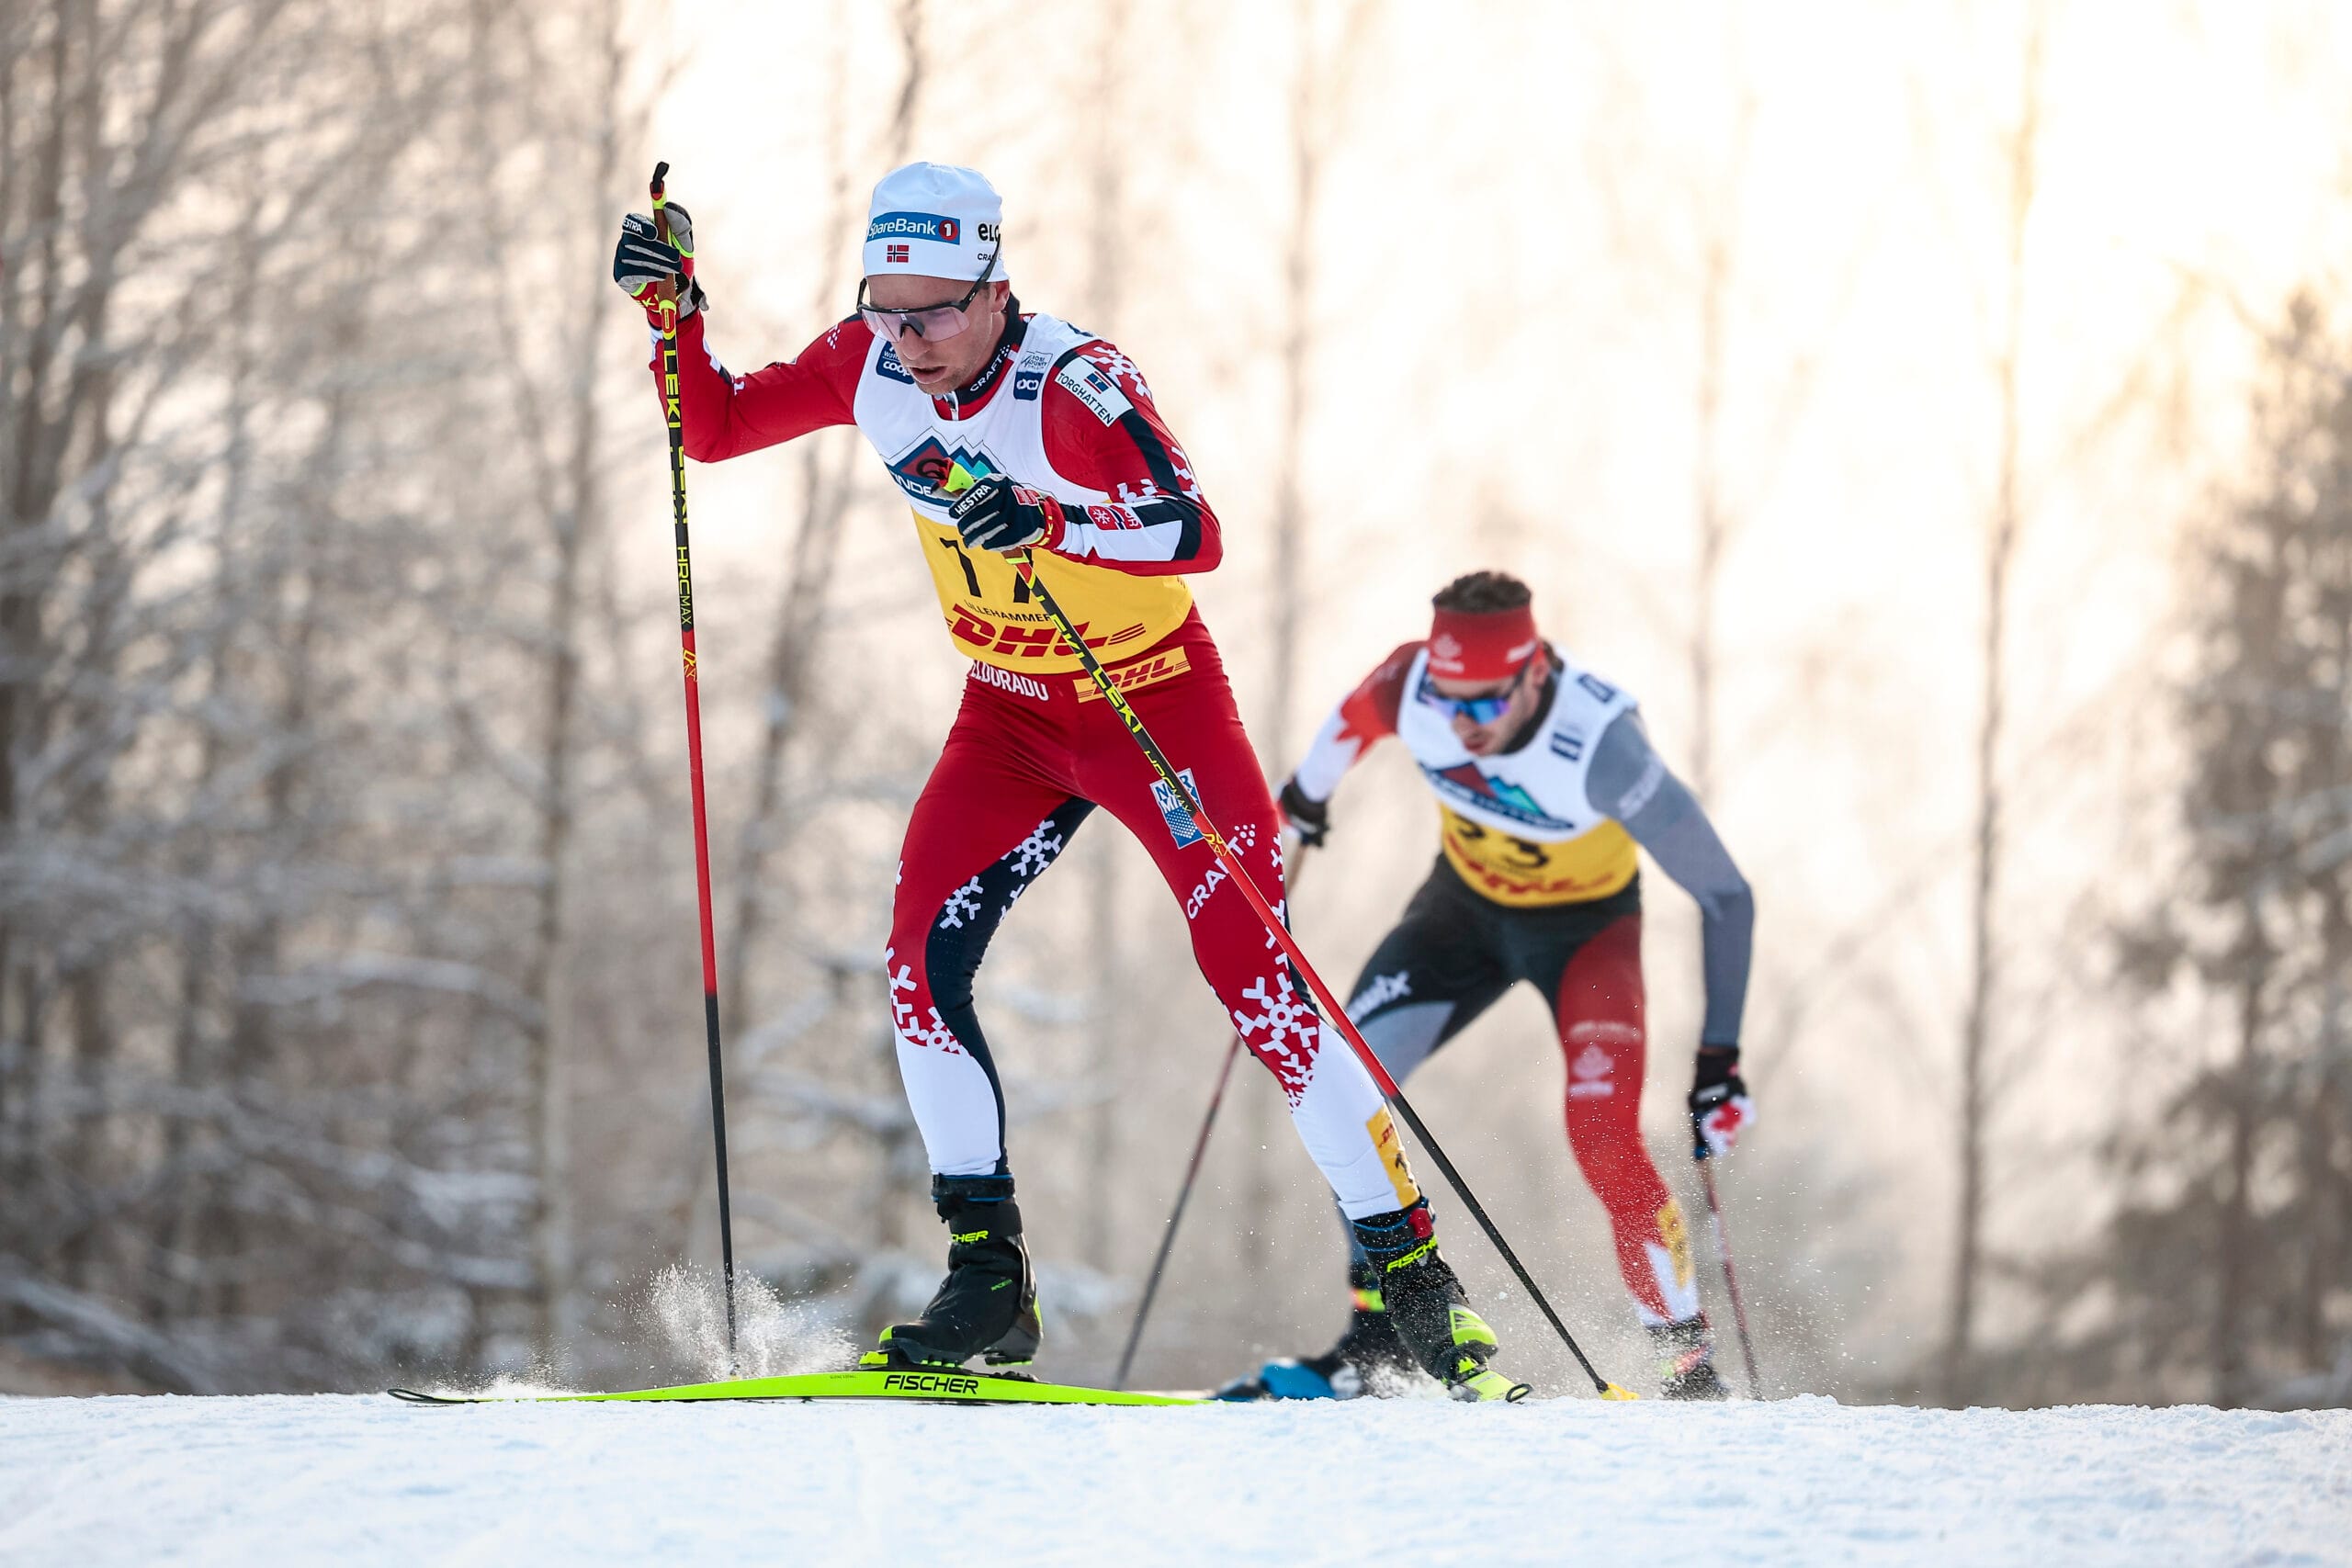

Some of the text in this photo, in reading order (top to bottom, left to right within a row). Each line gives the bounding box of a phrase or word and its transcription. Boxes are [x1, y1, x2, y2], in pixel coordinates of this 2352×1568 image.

[868, 218, 952, 238] SpareBank 1
[664, 350, 681, 428] LEKI
[969, 355, 1002, 392] CRAFT
[1057, 372, 1114, 424] TORGHATTEN
[955, 484, 991, 515] HESTRA
[952, 603, 1109, 658] DHL
[1092, 657, 1175, 695] DHL
[1092, 668, 1143, 733] LEKI
[884, 1374, 979, 1395] FISCHER
